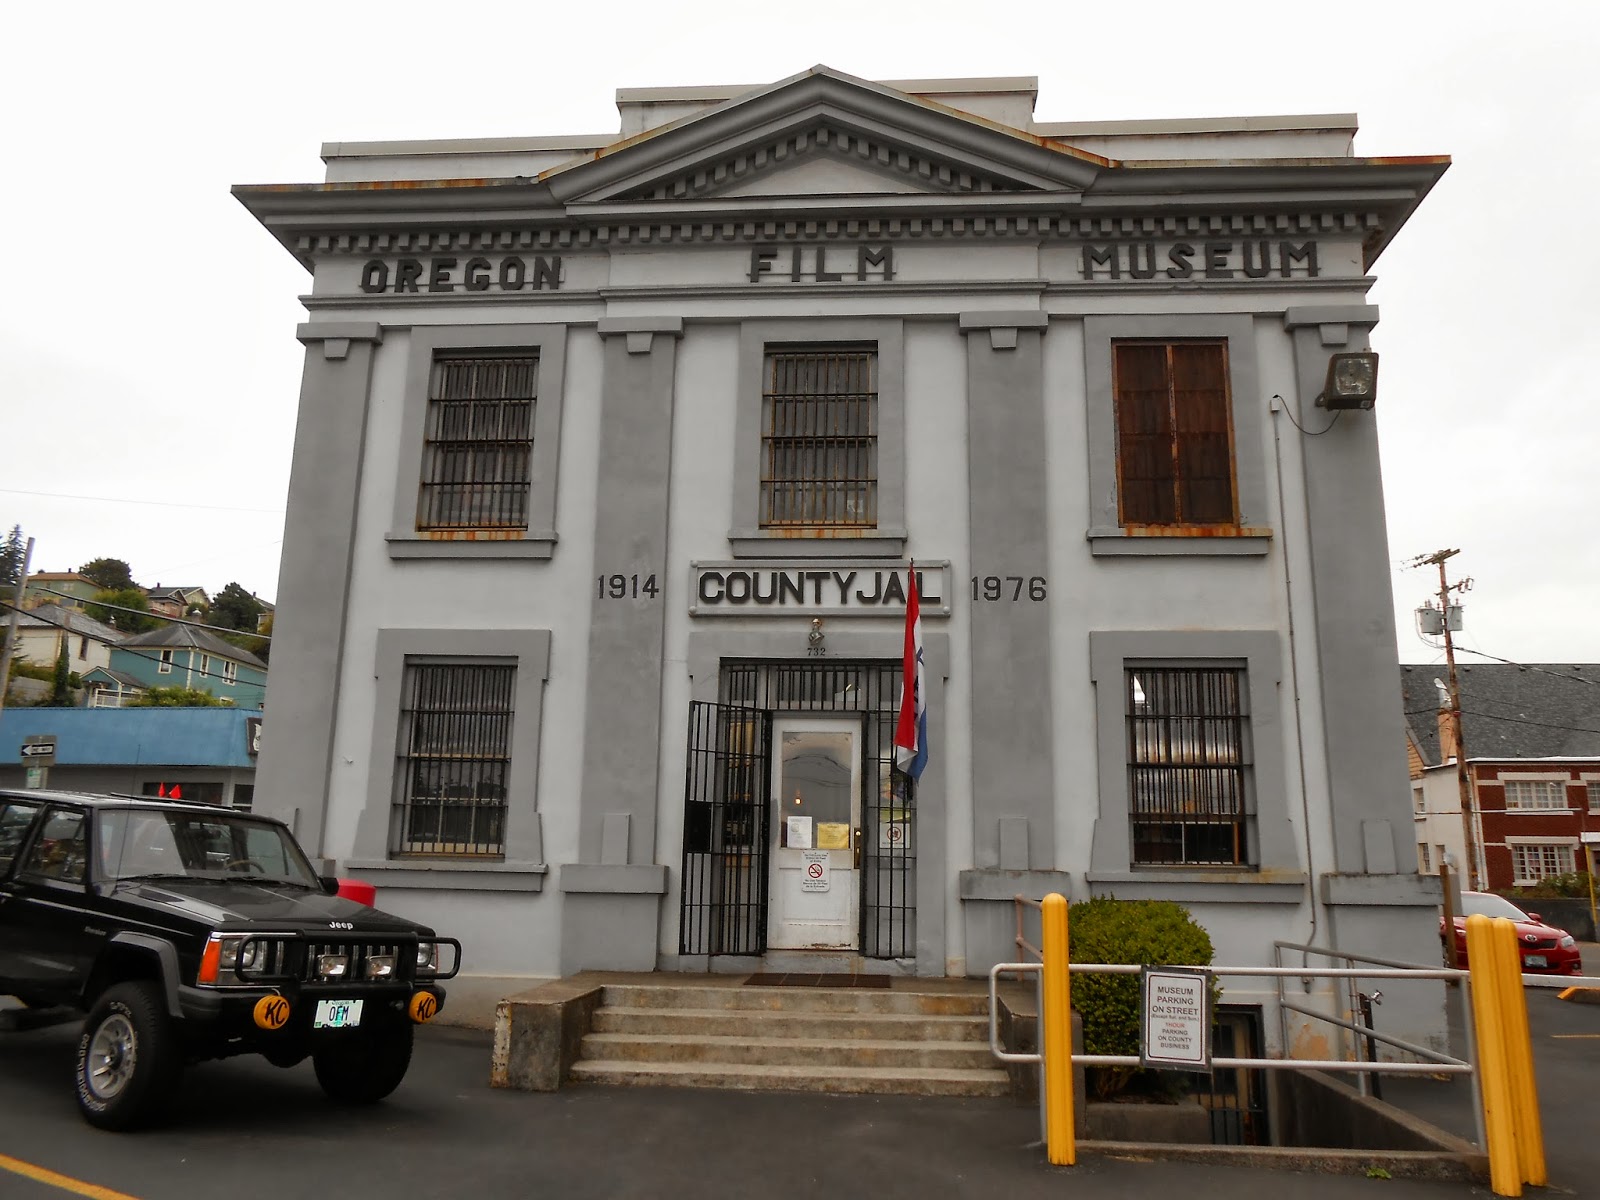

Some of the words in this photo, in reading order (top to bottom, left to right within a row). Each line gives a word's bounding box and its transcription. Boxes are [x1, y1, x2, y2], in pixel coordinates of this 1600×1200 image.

[361, 256, 561, 293] OREGON
[750, 246, 893, 282] FILM
[1082, 241, 1318, 280] MUSEUM
[597, 574, 660, 600] 1914
[856, 571, 941, 604] JAL
[971, 576, 1048, 602] 1976
[807, 647, 826, 656] 732
[328, 921, 354, 931] Jeep
[1158, 986, 1193, 995] MUSEUM
[1157, 995, 1194, 1005] PARKING
[264, 1000, 287, 1026] KC
[417, 997, 435, 1020] KC
[1152, 1005, 1164, 1013] ON
[1166, 1006, 1199, 1016] STREET
[1162, 1028, 1188, 1036] PARKING
[1160, 1042, 1190, 1050] BUSINESS
